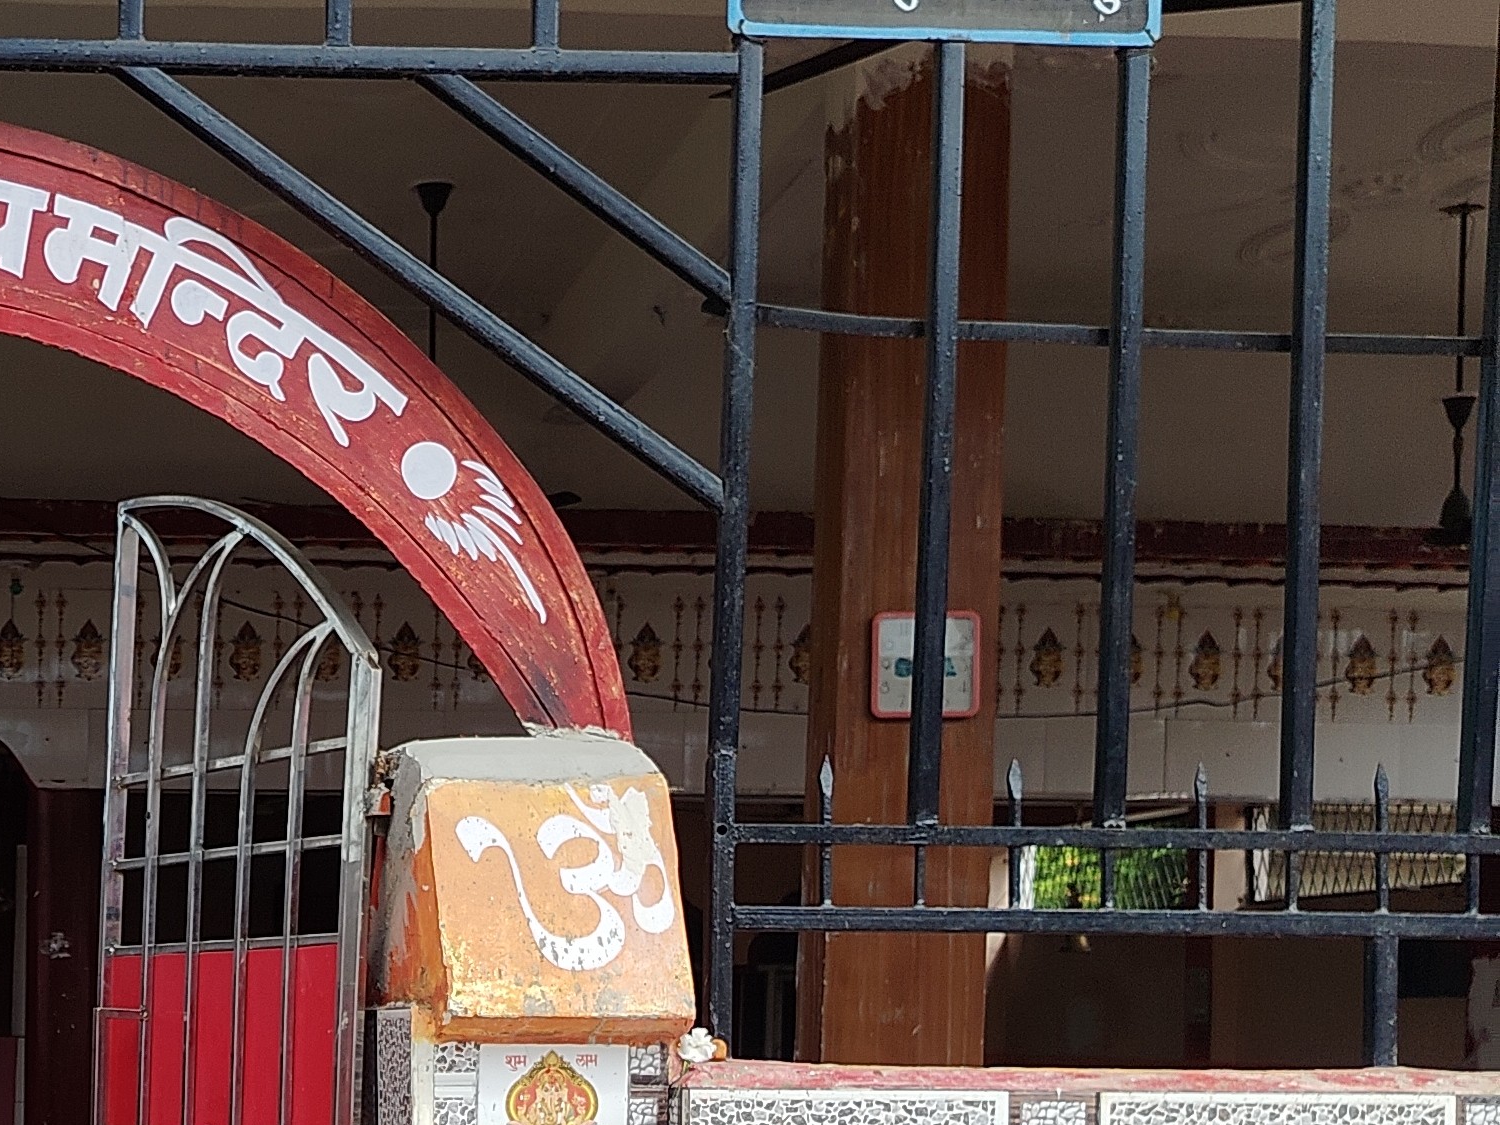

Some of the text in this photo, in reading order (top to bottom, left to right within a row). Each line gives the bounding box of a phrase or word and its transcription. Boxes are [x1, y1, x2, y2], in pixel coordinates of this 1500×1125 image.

[44, 191, 409, 448] मन्दिर
[505, 1053, 598, 1071] शुभ लाभ
